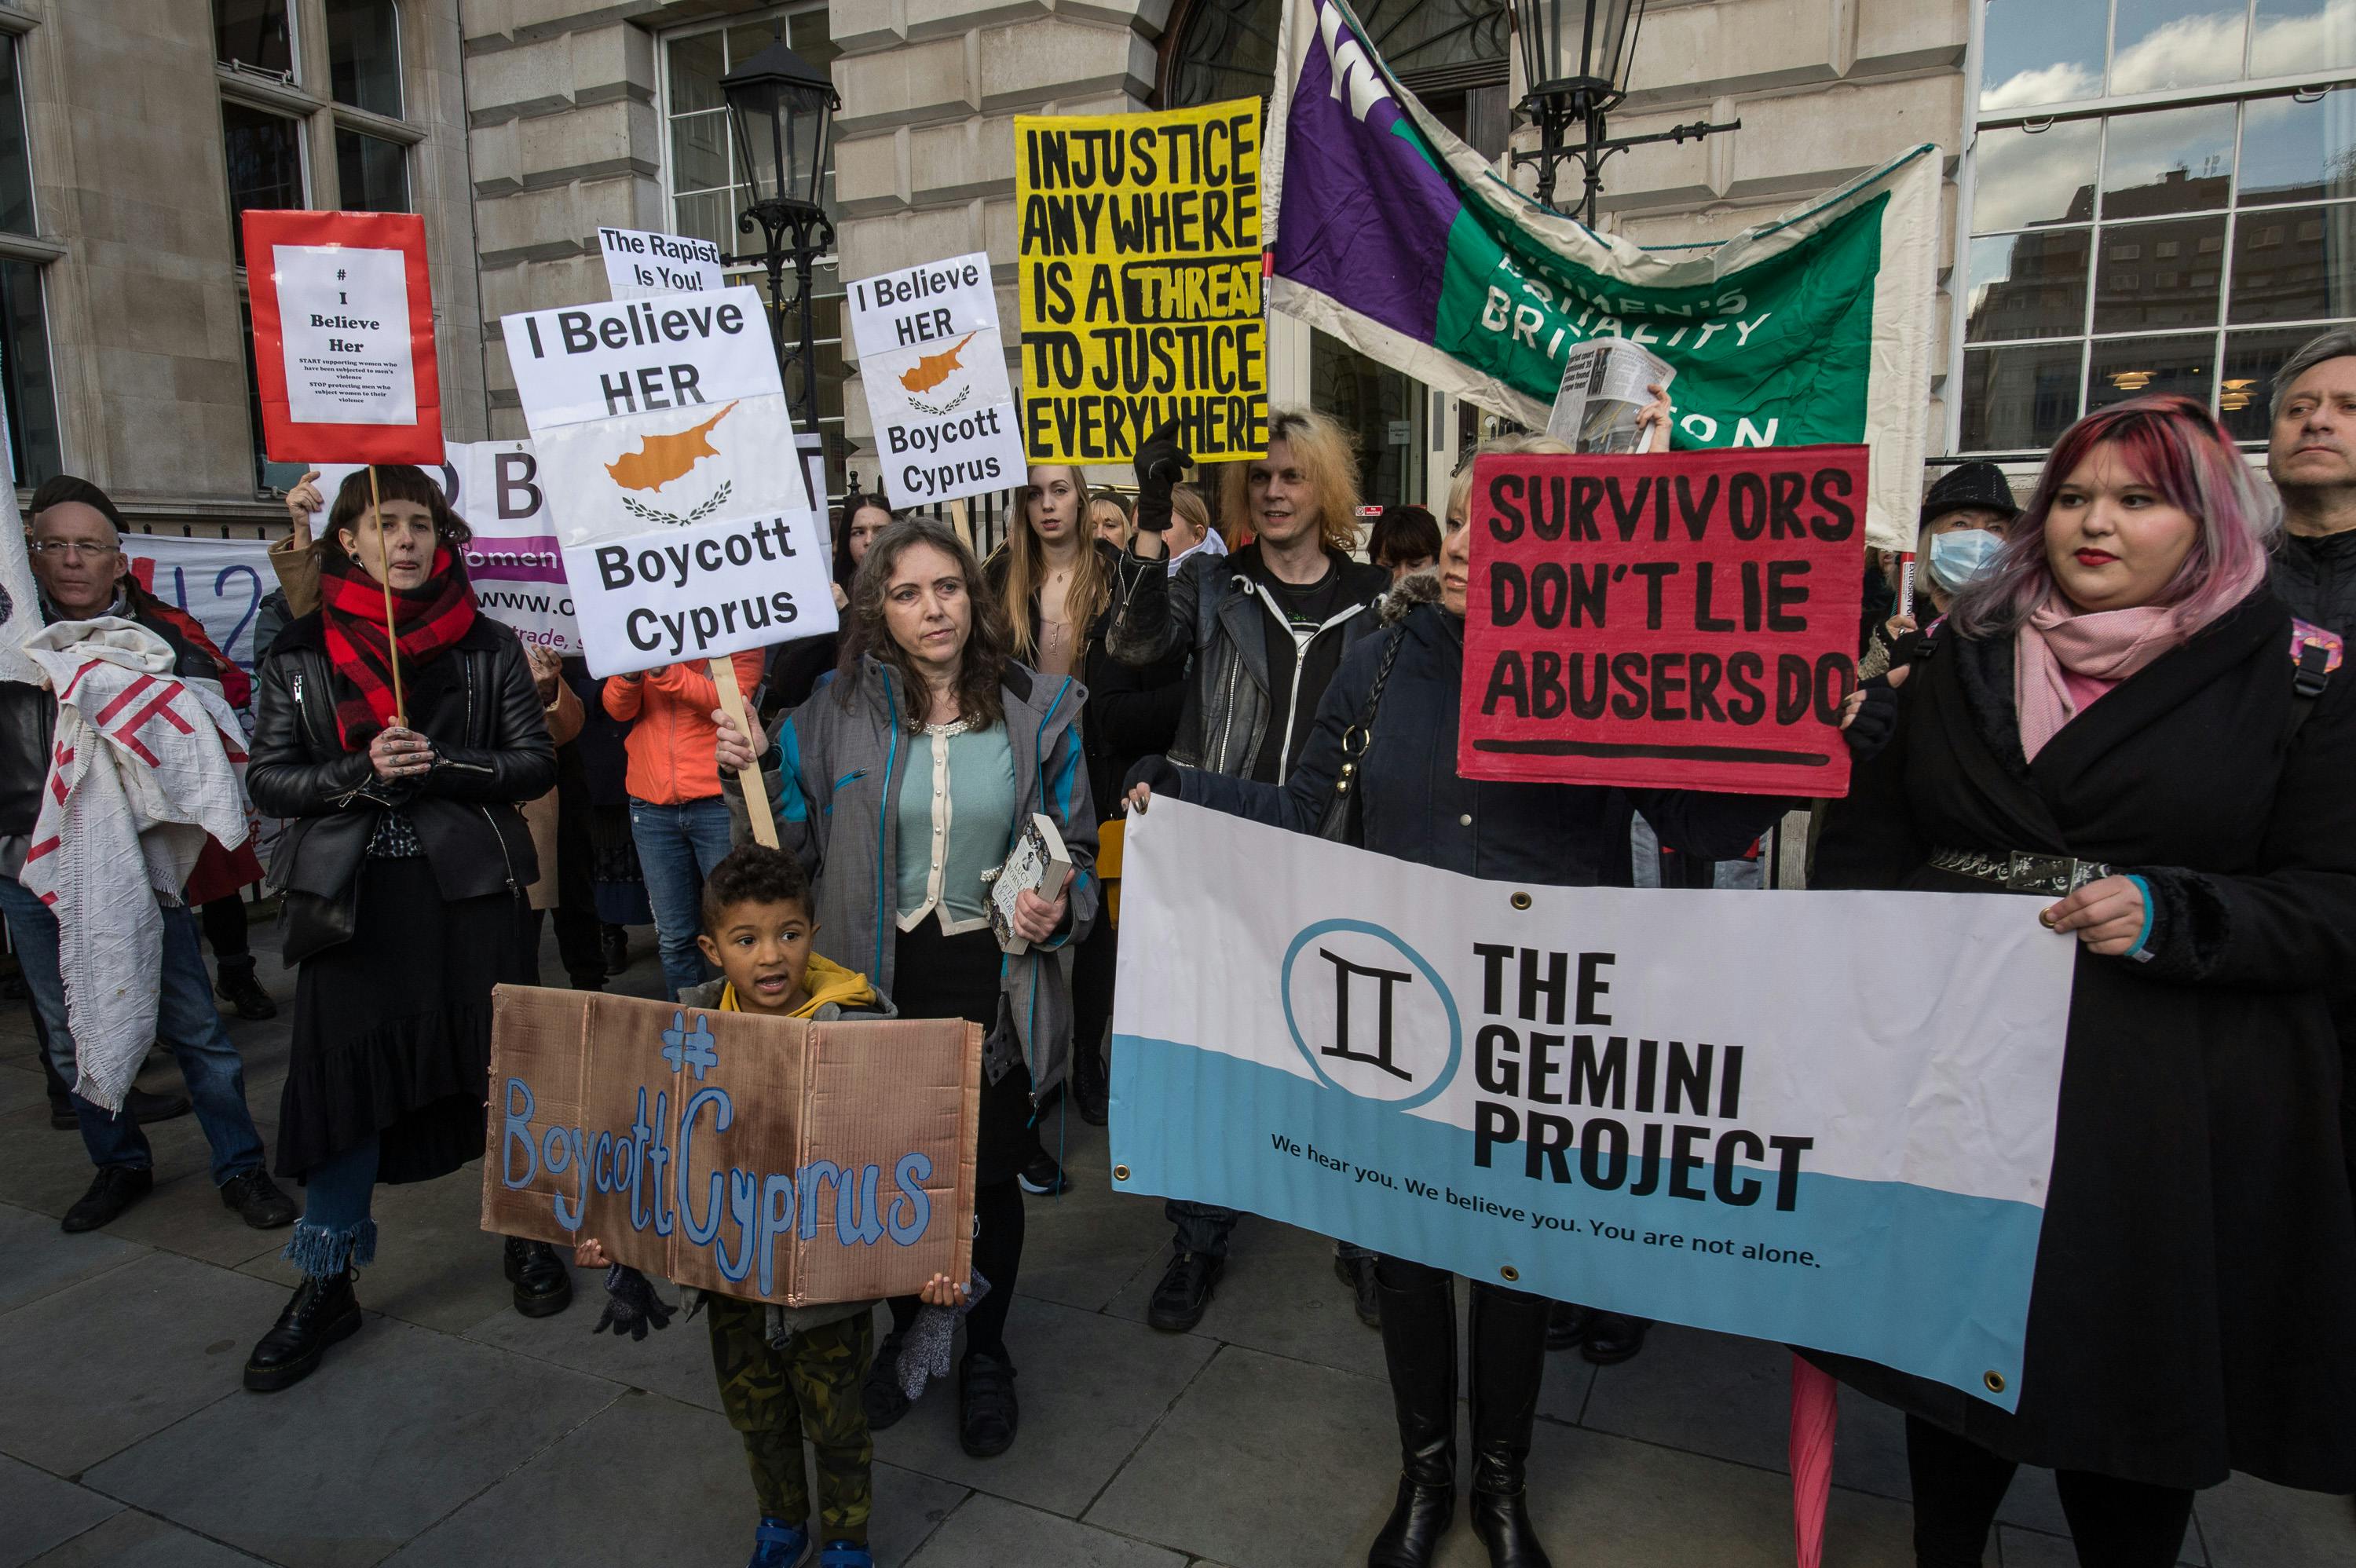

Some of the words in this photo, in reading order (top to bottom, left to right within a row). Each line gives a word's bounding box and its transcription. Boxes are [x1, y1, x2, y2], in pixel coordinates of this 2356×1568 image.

[1027, 115, 1256, 190] INJUSTICE
[600, 228, 645, 254] The
[649, 234, 719, 265] Rapist
[1021, 185, 1257, 257] ANYWHERE
[337, 269, 346, 281] #
[339, 292, 348, 305] I
[634, 264, 654, 287] Is
[657, 266, 704, 291] You!
[856, 284, 867, 312] I
[875, 264, 979, 307] Believe
[1033, 261, 1077, 324] IS
[1085, 264, 1118, 323] A
[1128, 264, 1262, 320] THREAT
[310, 314, 380, 330] Believe
[329, 338, 364, 353] Her
[525, 316, 546, 359] I
[558, 302, 744, 355] Believe
[894, 308, 956, 347] HER
[1021, 331, 1083, 389] TO
[1090, 324, 1261, 393] JUSTICE
[599, 362, 707, 417] HER
[887, 406, 1001, 455] Boycott
[902, 455, 1001, 497] Cyprus
[1489, 468, 1855, 543] SURVIVORS
[465, 550, 558, 569] omen
[594, 517, 796, 591] Boycott
[476, 592, 575, 617] www.o
[626, 588, 799, 656] Cyprus
[1491, 561, 1679, 630] DON'T
[1695, 560, 1812, 633] LIE
[1481, 649, 1767, 726] ABUSERS
[1776, 652, 1855, 726] DO
[997, 884, 1015, 914] VICTORI
[1014, 862, 1030, 884] LUCY
[1473, 942, 1616, 1026] THE
[660, 1010, 719, 1081] #
[1473, 1024, 1745, 1120] GEMINI
[1474, 1101, 1814, 1212] PROJECT
[1271, 1133, 1301, 1157] We
[1308, 1143, 1350, 1174] hear
[1355, 1165, 1399, 1190] you.
[1404, 1177, 1439, 1201] We
[1446, 1186, 1525, 1222] believe
[1531, 1212, 1582, 1233] you.
[1589, 1219, 1635, 1242] You
[1642, 1230, 1685, 1248] are
[1692, 1237, 1735, 1255] not
[1741, 1243, 1821, 1269] alone.
